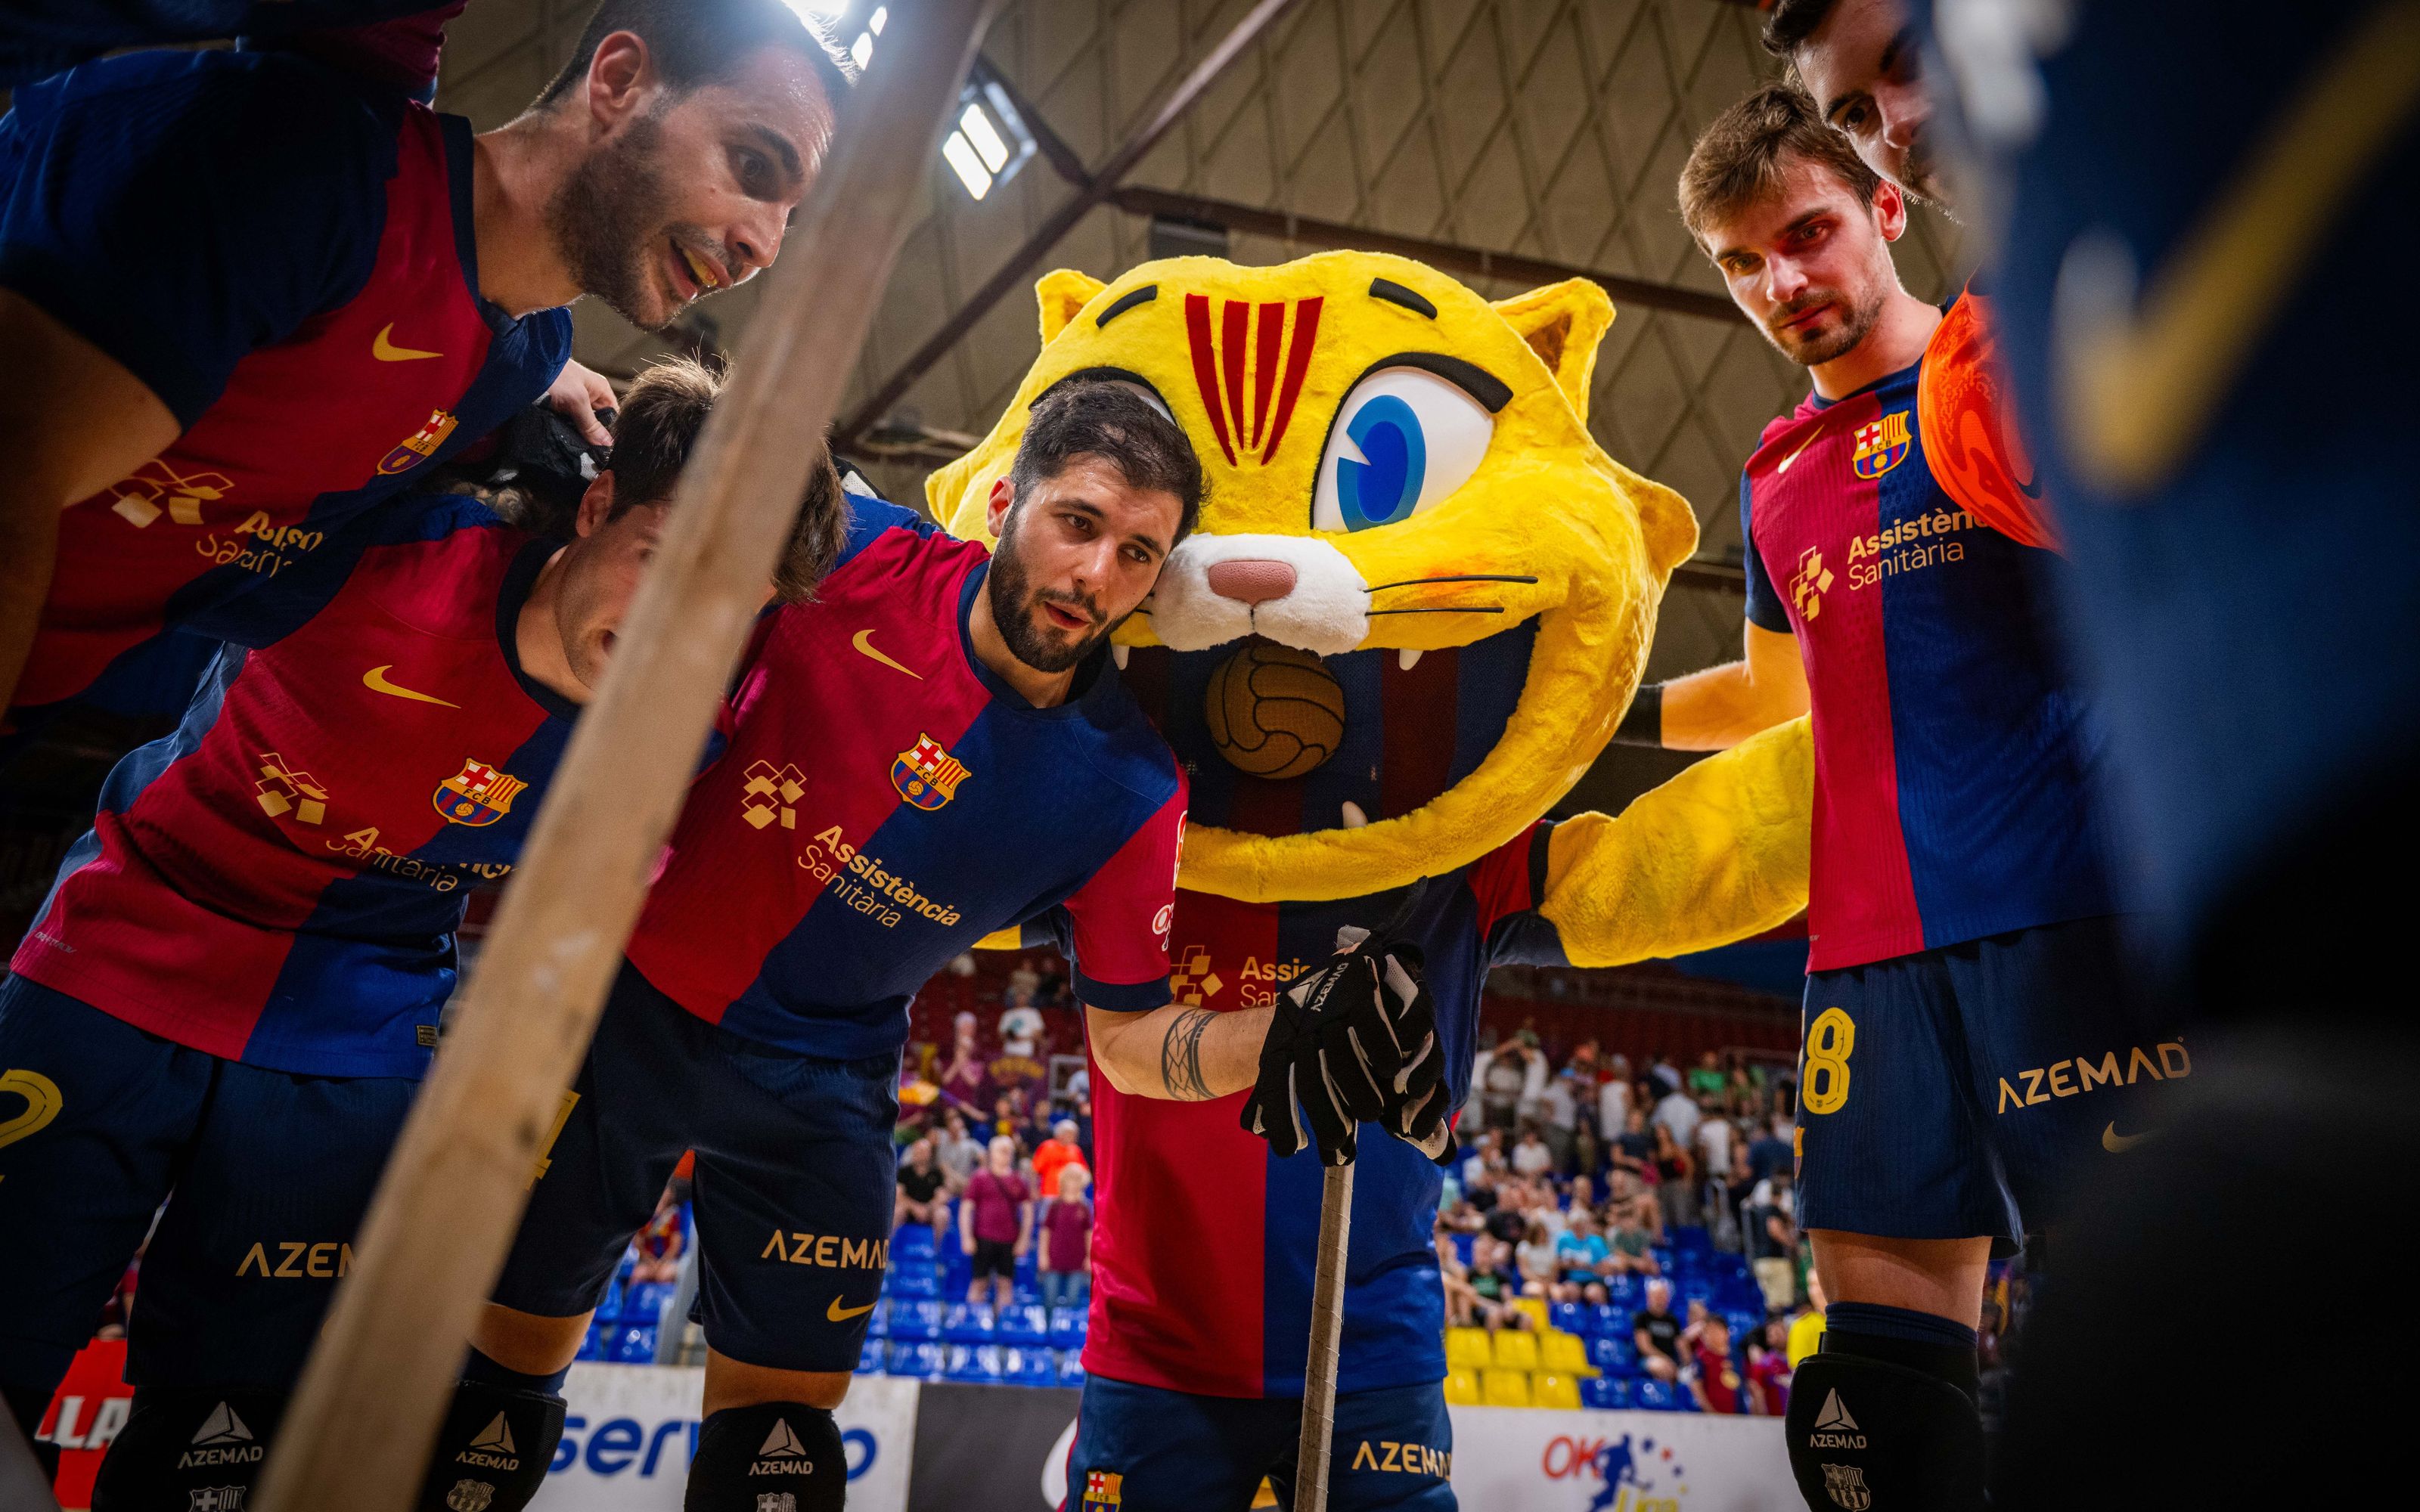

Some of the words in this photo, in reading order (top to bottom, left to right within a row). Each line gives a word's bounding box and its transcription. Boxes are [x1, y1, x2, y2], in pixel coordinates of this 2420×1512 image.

[1869, 440, 1892, 454] FCB
[1849, 537, 1965, 591] Sanitària
[915, 765, 939, 786] FCB
[462, 788, 492, 805] FCB
[798, 844, 901, 928] Sanitària
[814, 825, 961, 926] Assistència
[1998, 1042, 2192, 1114] AZEMAD
[1810, 1433, 1867, 1449] AZEMAD
[178, 1445, 263, 1469] AZEMAD
[455, 1451, 520, 1470] AZEMAD
[748, 1460, 813, 1476] AZEMAD
